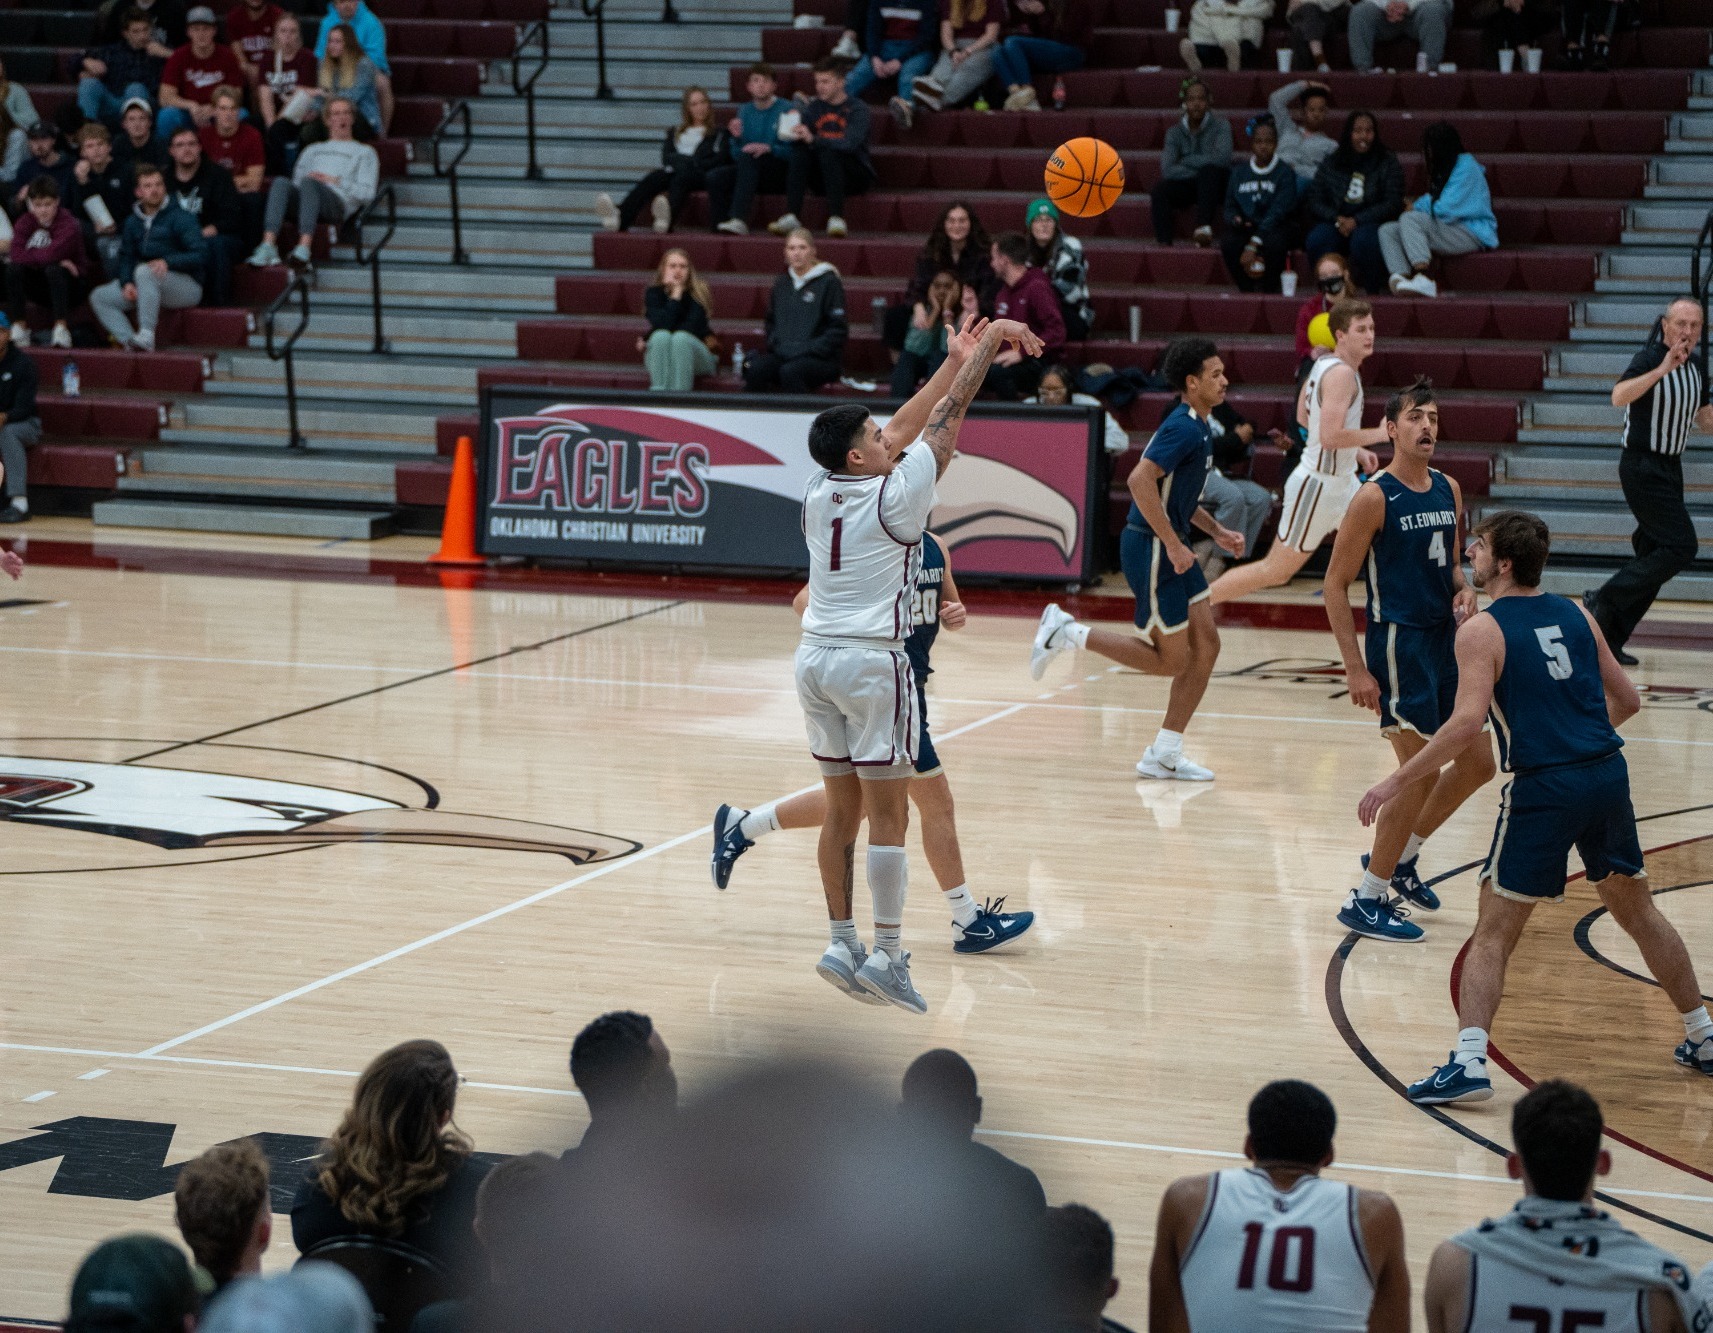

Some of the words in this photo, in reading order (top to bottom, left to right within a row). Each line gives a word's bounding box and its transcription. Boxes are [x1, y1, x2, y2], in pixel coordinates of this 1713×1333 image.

[489, 416, 711, 518] EAGLES
[832, 492, 843, 504] OC
[490, 516, 558, 538] OKLAHOMA
[562, 520, 628, 542] CHRISTIAN
[632, 523, 706, 545] UNIVERSITY
[830, 517, 843, 571] 1
[1428, 530, 1447, 568] 4
[911, 588, 938, 625] 20
[1533, 624, 1573, 681] 5
[1236, 1220, 1316, 1293] 10
